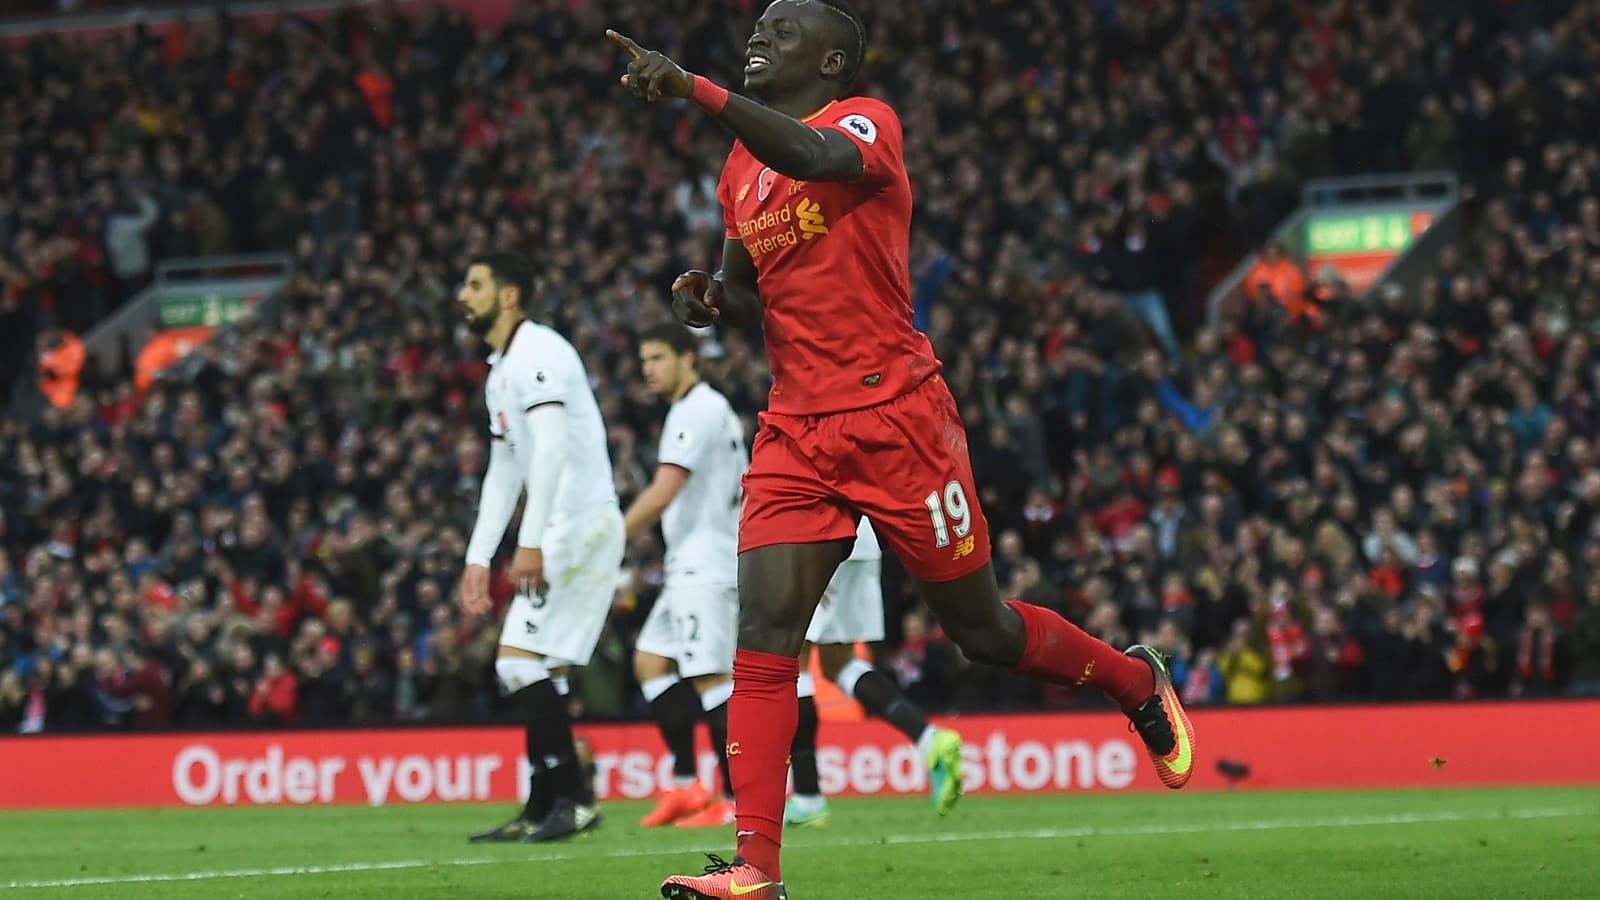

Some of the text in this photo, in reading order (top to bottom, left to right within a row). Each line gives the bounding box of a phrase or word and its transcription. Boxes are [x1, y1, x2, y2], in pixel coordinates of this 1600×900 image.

[748, 226, 797, 257] artered
[925, 481, 971, 548] 19
[173, 745, 346, 805] Order
[357, 755, 502, 806] your
[960, 733, 1137, 791] stone
